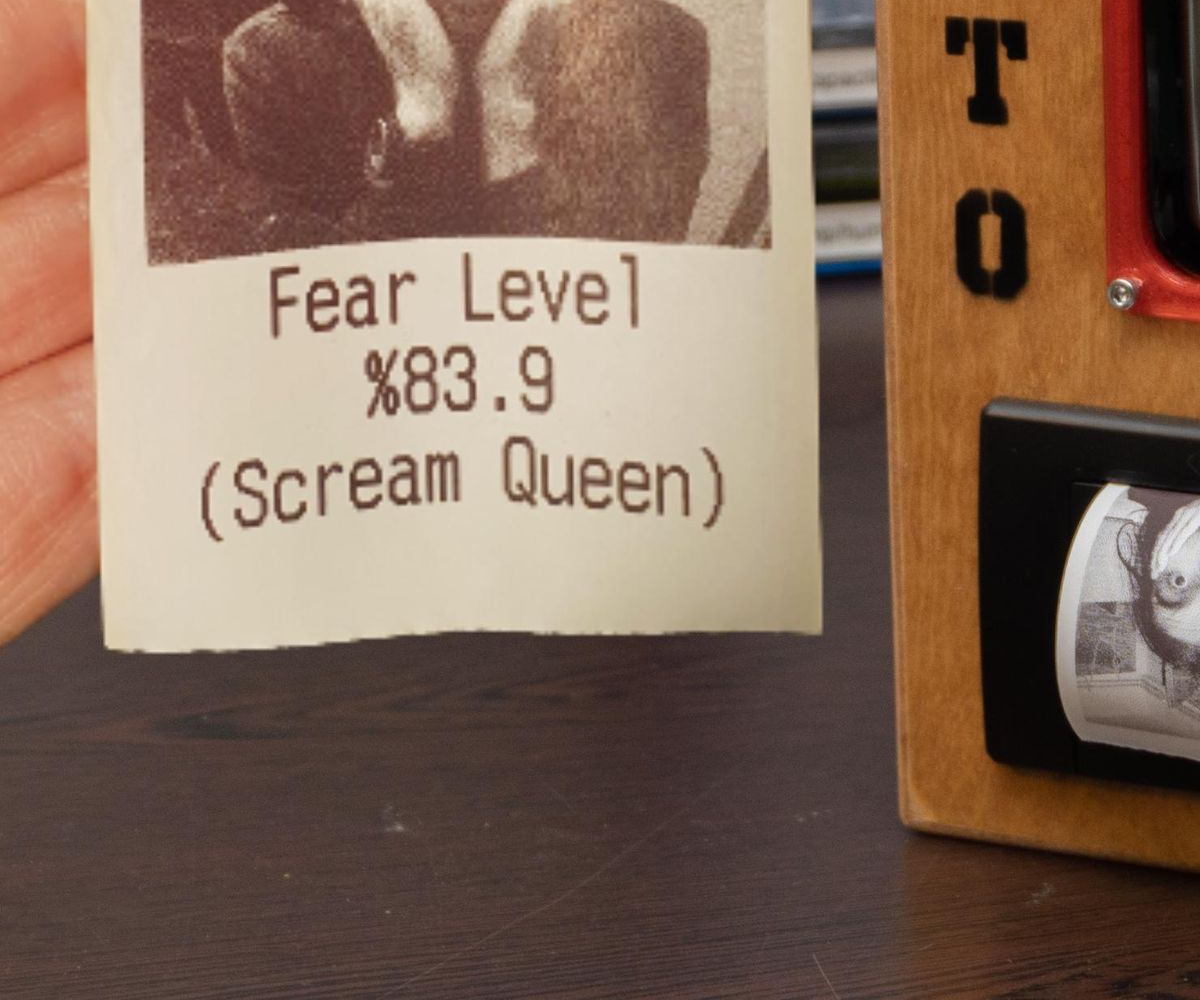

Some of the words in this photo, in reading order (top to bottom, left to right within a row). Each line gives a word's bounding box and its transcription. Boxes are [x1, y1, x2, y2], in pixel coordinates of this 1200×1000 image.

[268, 264, 416, 339] Fear
[462, 252, 639, 328] Level
[364, 345, 554, 418] %83.9
[200, 450, 461, 542] (Scream
[502, 435, 725, 530] Queen)
